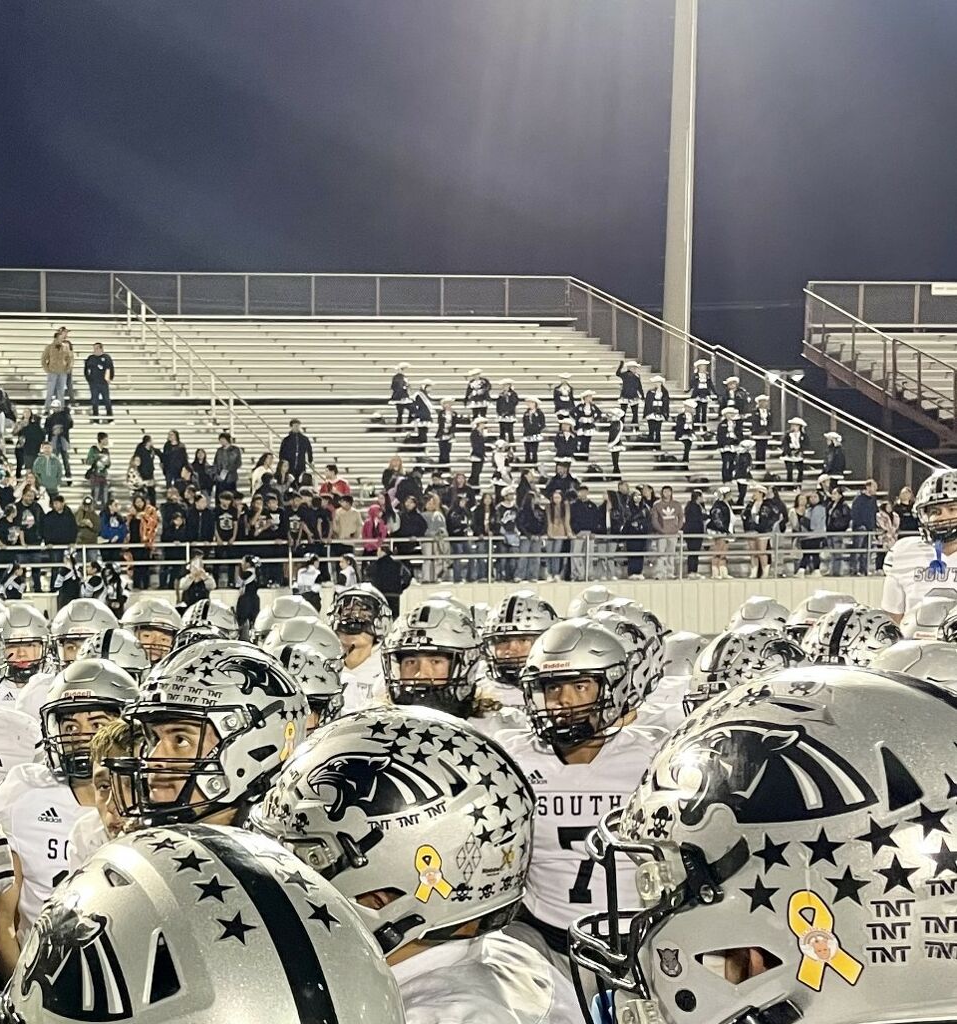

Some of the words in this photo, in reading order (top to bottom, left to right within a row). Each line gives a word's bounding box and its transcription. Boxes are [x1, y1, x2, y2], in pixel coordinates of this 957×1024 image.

[188, 687, 203, 695] TNT
[207, 690, 223, 698] TNT
[538, 795, 623, 817] SOUTH
[367, 819, 391, 831] TNT
[396, 813, 421, 828] TNT
[424, 800, 447, 819] TNT
[556, 826, 601, 904] 7
[925, 878, 957, 896] TN
[870, 899, 915, 917] TNT
[866, 922, 911, 940] TNT
[866, 946, 911, 963] TNT
